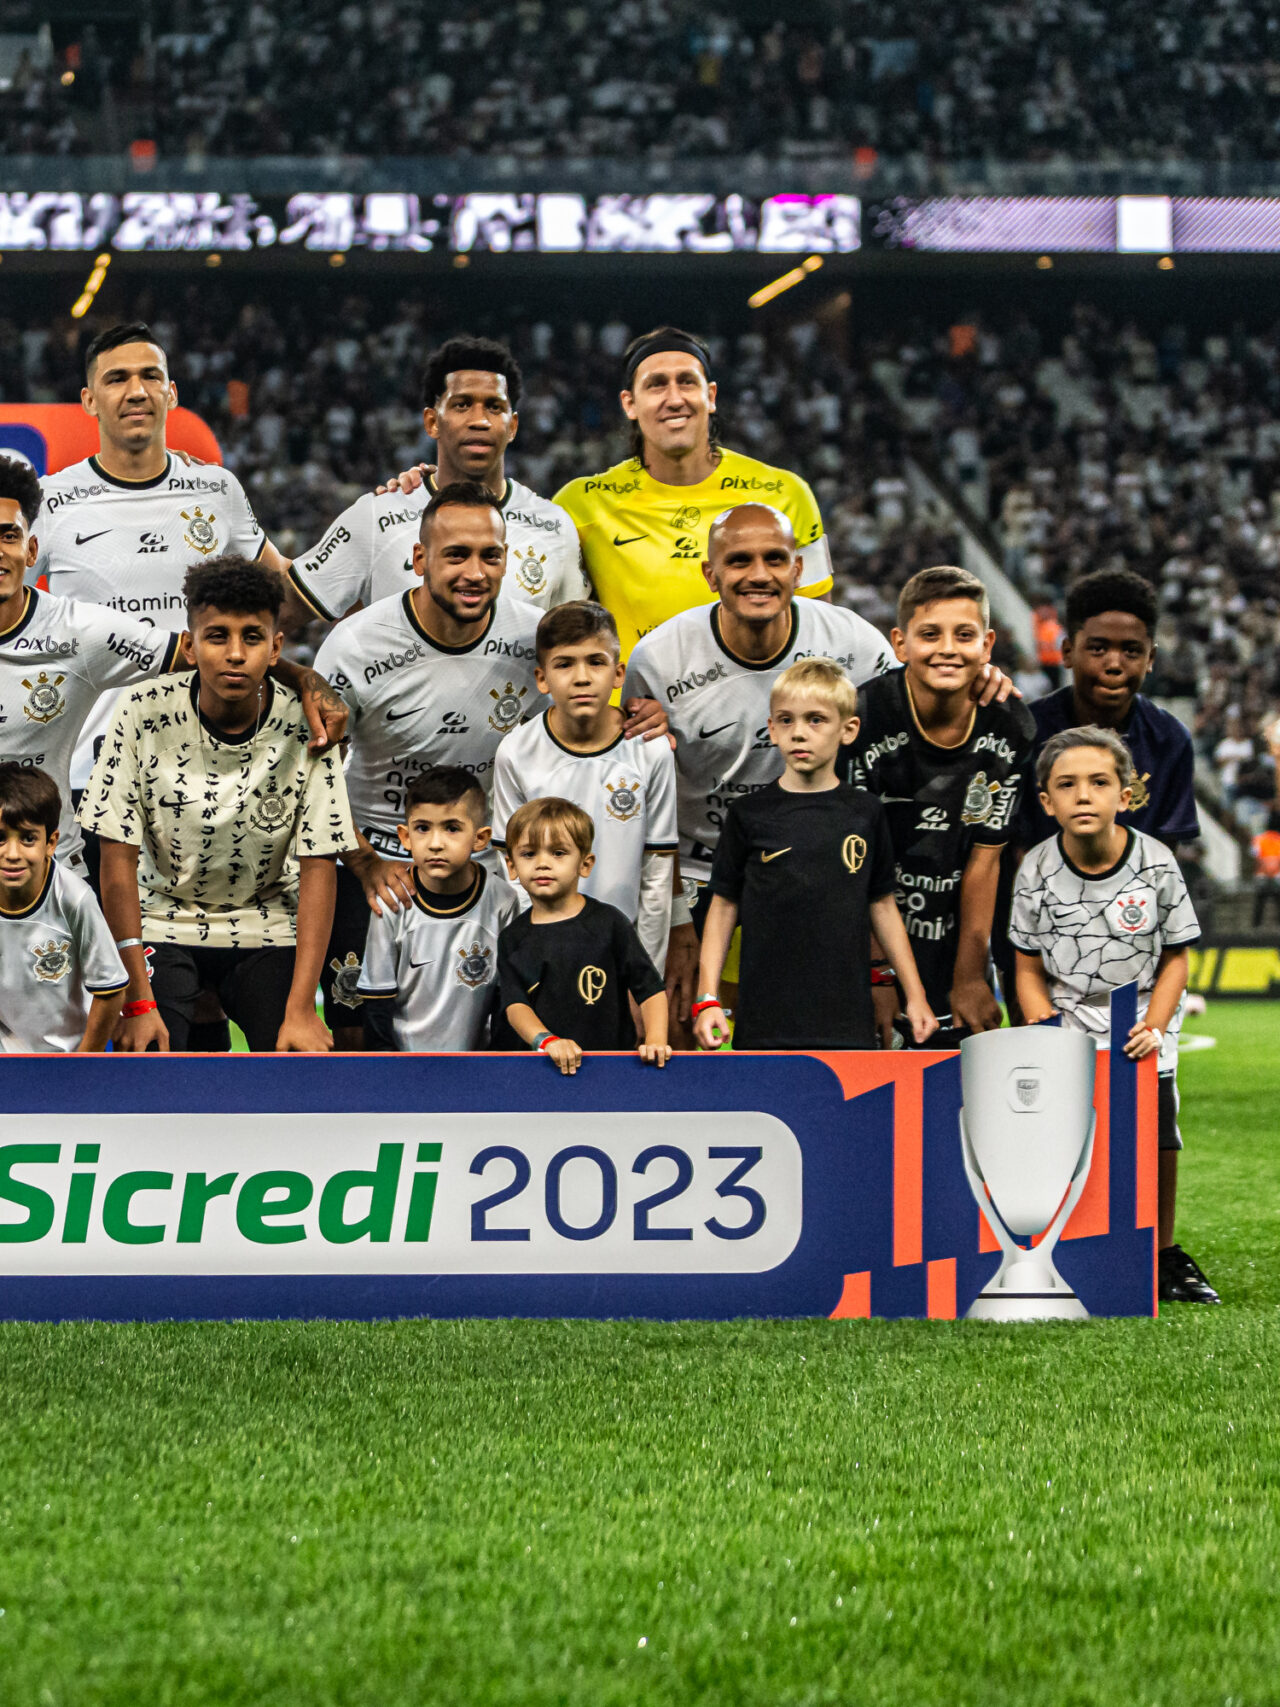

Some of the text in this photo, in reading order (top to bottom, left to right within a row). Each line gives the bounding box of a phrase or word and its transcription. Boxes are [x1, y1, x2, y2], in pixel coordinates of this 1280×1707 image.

[169, 477, 228, 495] pixbet
[585, 478, 643, 494] pixbet
[720, 475, 784, 494] pixbet
[47, 483, 110, 513] pixbet
[506, 510, 562, 534] pixbet
[137, 545, 169, 553] ALE
[315, 525, 352, 564] bmg
[671, 551, 703, 559] ALE
[14, 636, 80, 656] pixbet
[115, 639, 156, 671] bmg
[364, 643, 426, 684] pixbet
[667, 662, 728, 703] pixbet
[436, 725, 470, 734] ALE
[915, 822, 951, 831] ALE
[469, 1144, 767, 1241] 2023
